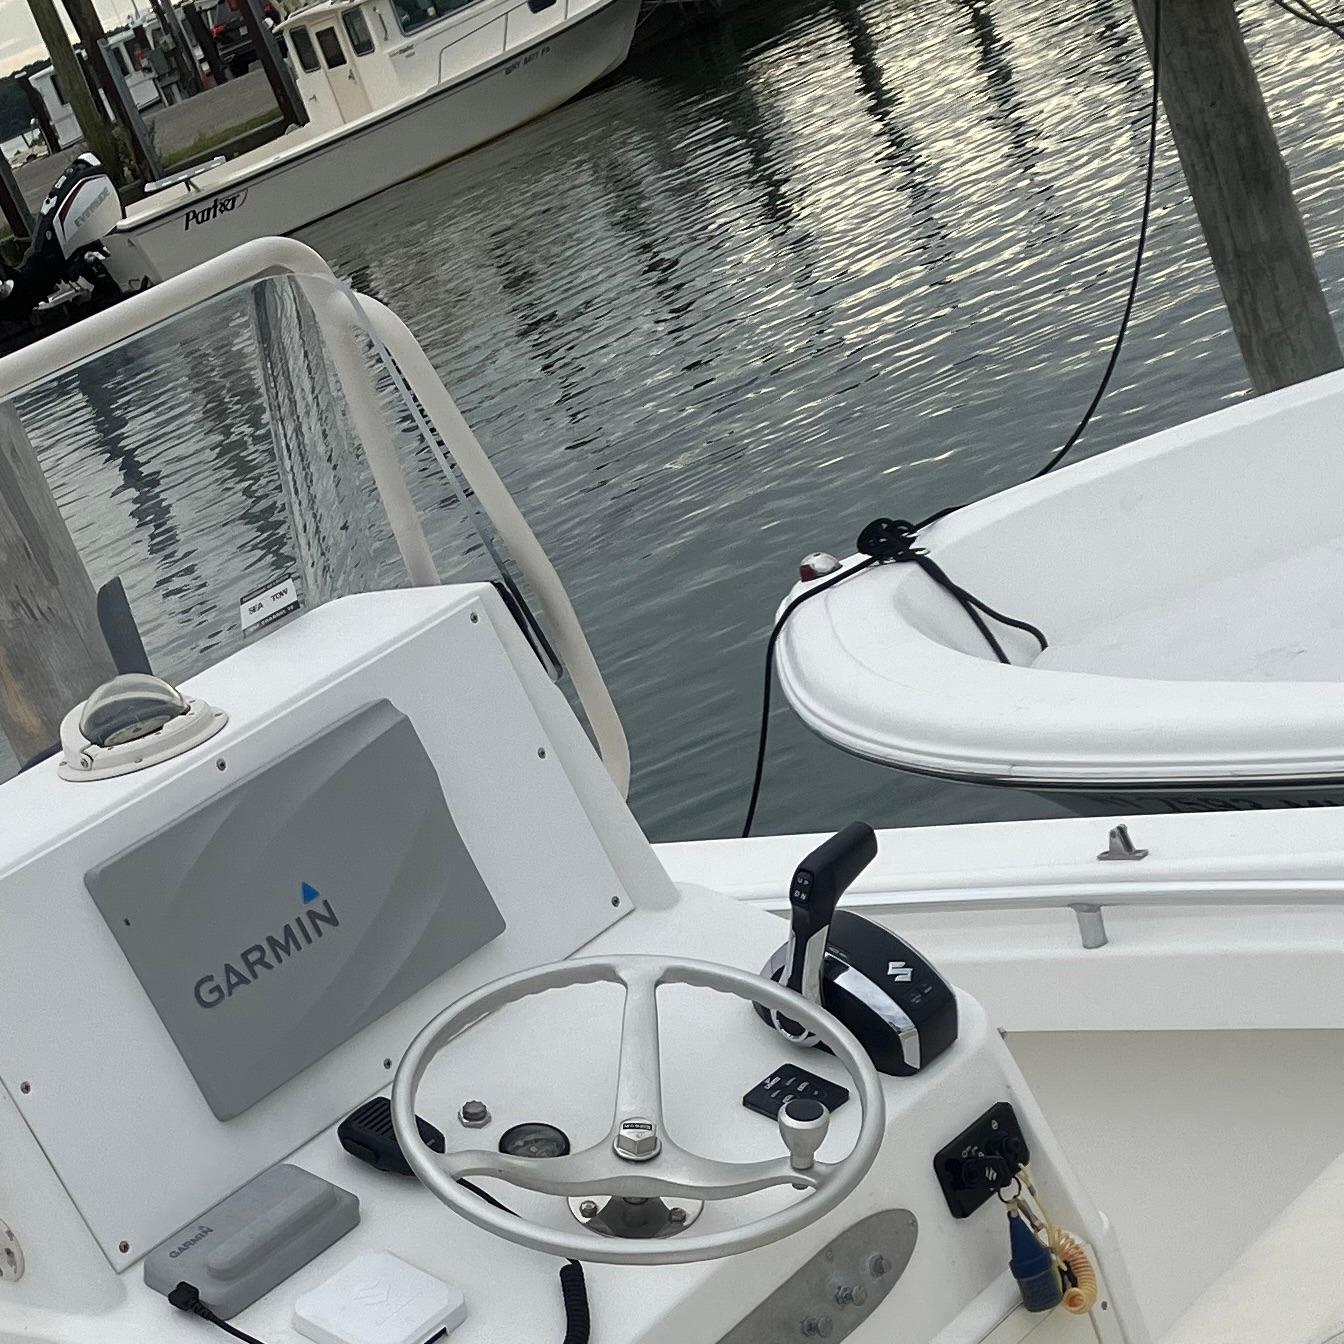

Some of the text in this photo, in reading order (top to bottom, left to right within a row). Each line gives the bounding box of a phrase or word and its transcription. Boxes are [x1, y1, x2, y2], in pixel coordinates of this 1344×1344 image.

[184, 193, 242, 231] Parker
[248, 602, 264, 615] SEA
[270, 587, 289, 602] TOW
[193, 898, 340, 1009] GARMIN
[168, 1225, 214, 1259] GARMIN
